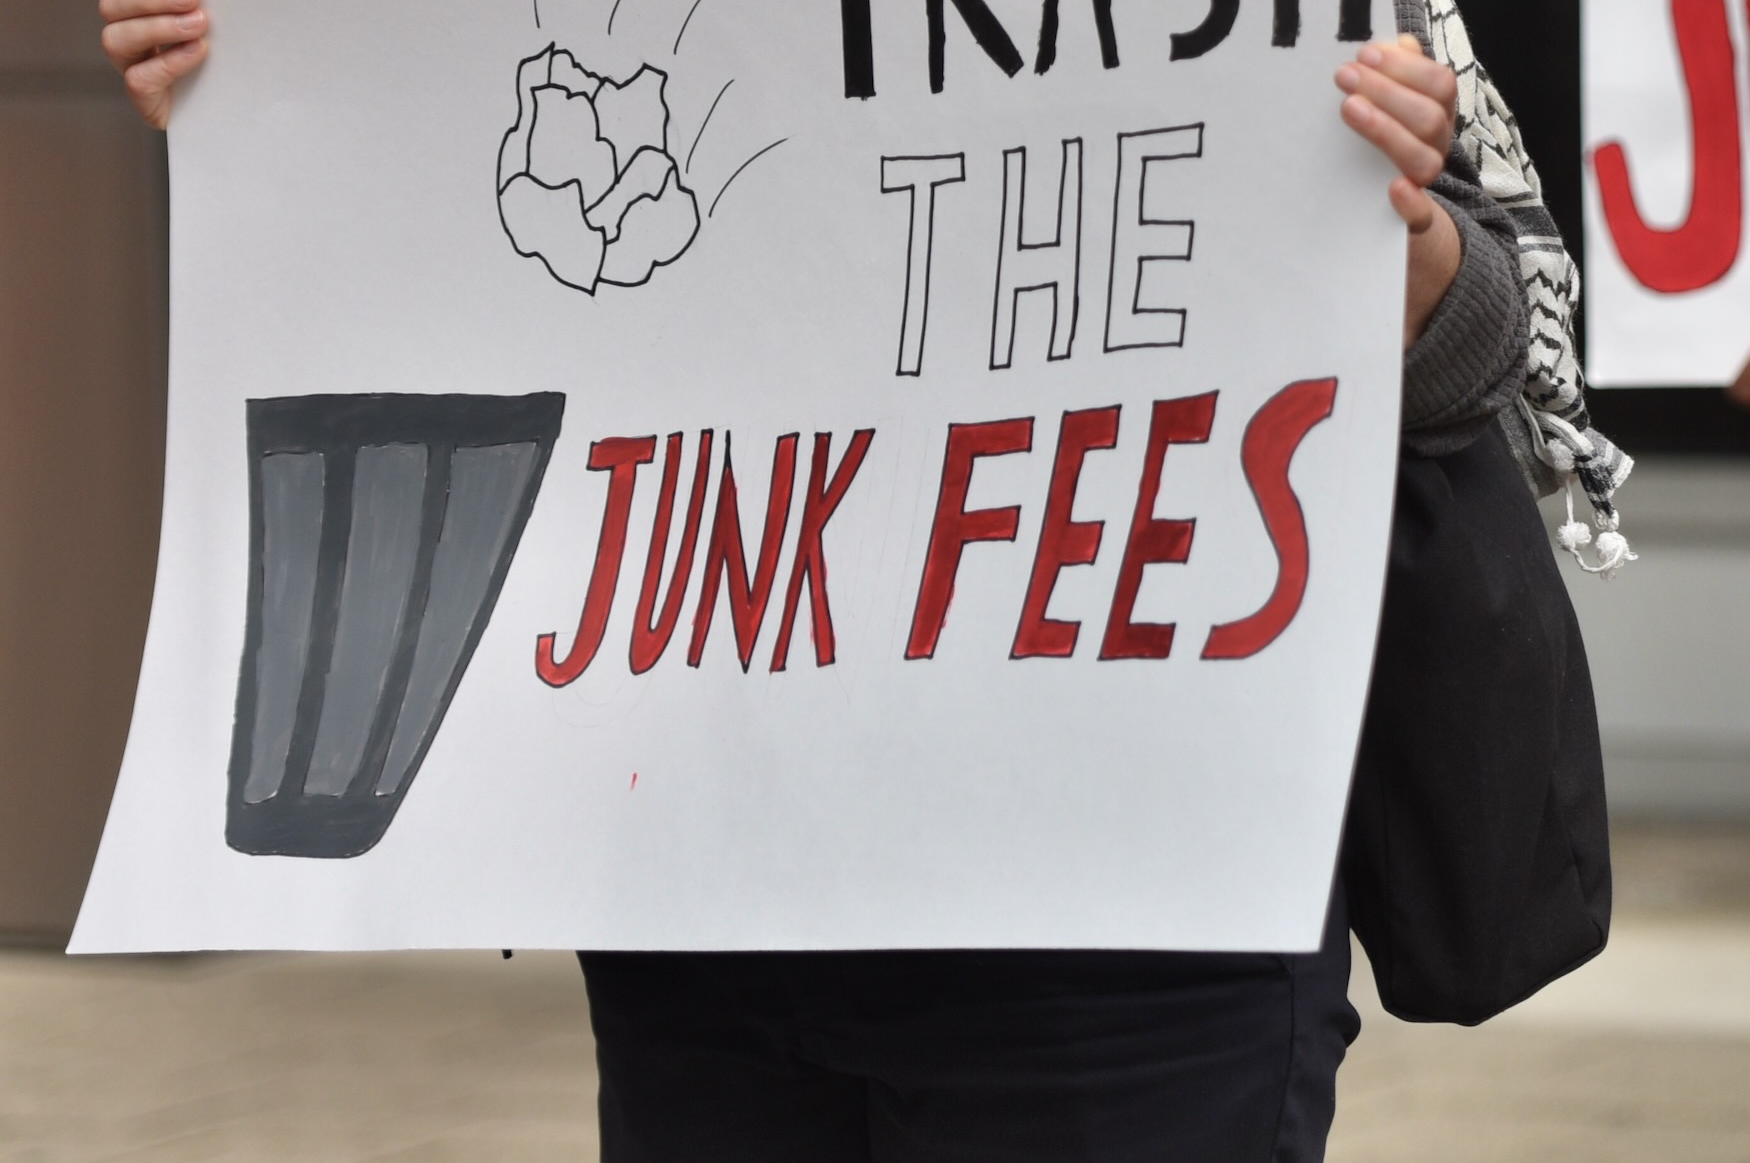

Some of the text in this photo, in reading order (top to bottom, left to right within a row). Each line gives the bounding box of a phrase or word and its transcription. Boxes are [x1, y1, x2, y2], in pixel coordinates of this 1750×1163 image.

[880, 121, 1206, 377] THE
[534, 375, 1339, 688] JUNK FEES
